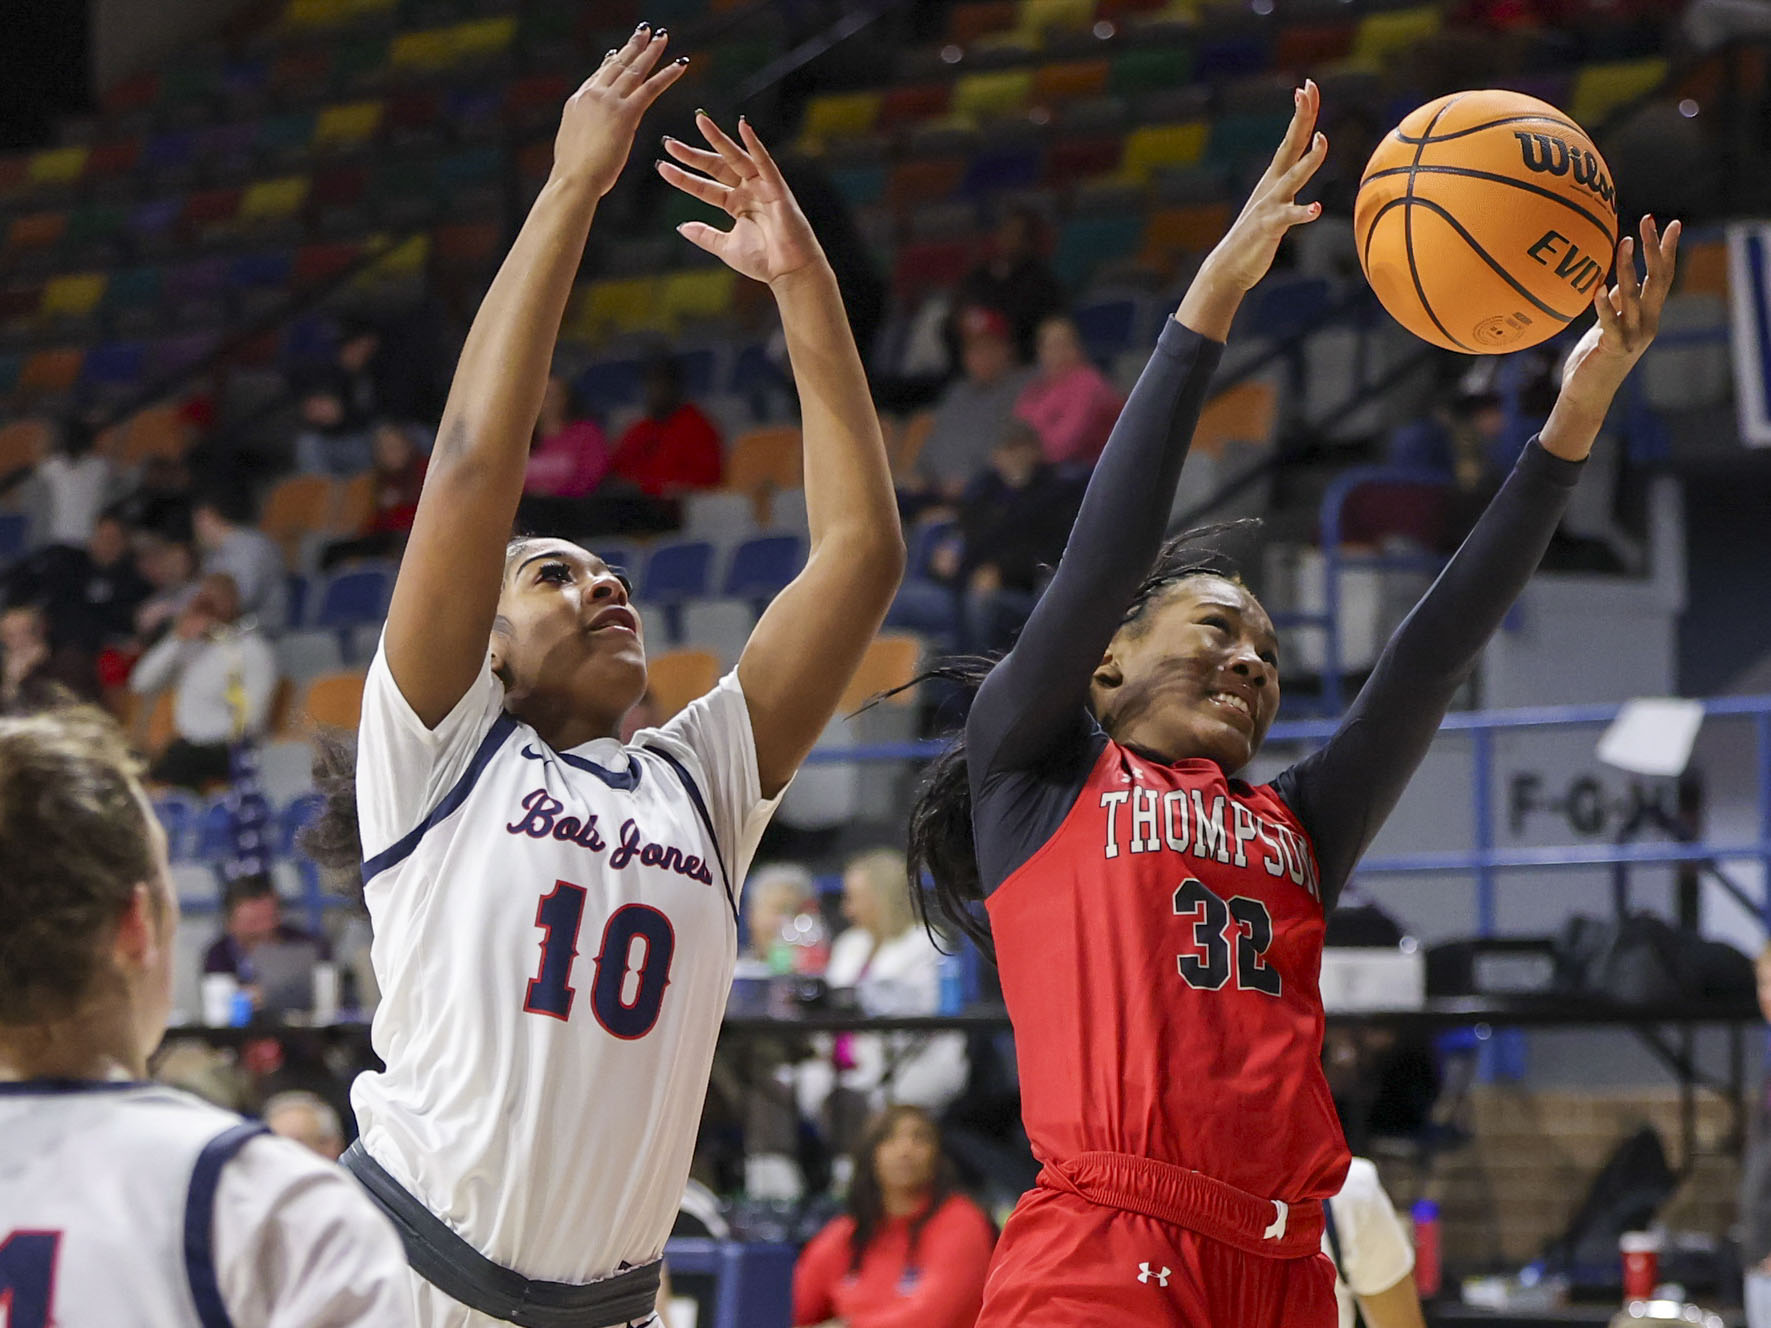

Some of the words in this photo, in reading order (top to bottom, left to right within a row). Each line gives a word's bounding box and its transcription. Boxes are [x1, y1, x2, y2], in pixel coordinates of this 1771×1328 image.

[1514, 131, 1617, 215] Wils
[506, 788, 606, 852] Bob
[609, 817, 713, 886] Jones
[1100, 785, 1320, 904] THOMPSON
[523, 879, 676, 1041] 10
[1172, 877, 1282, 997] 32
